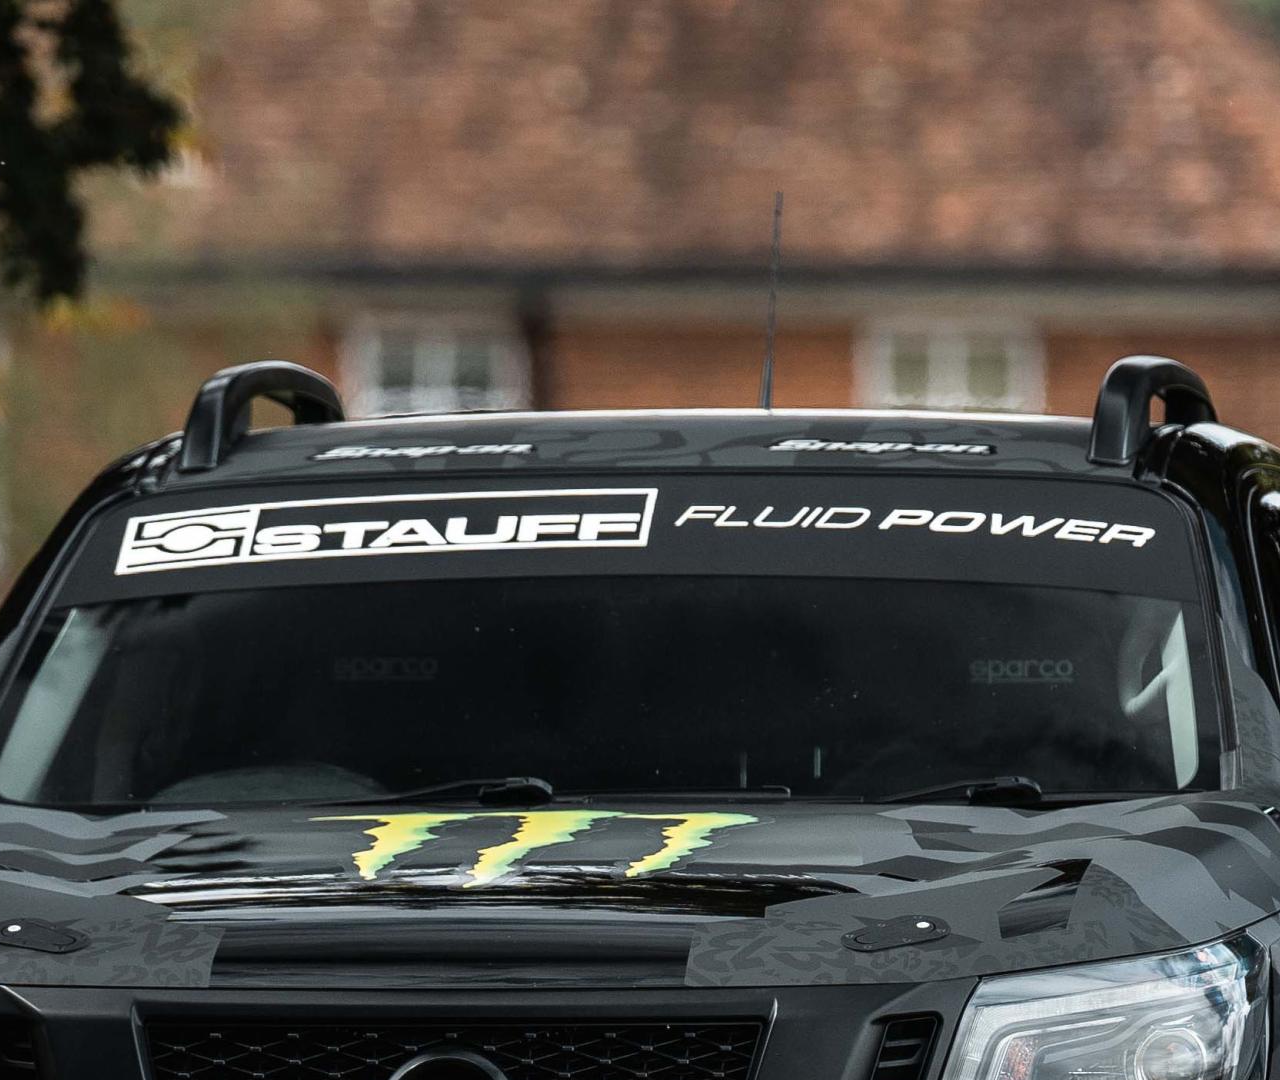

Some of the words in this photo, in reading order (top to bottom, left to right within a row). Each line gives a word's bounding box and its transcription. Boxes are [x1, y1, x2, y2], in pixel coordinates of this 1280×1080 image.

[254, 513, 642, 555] STAUFF
[674, 505, 871, 529] FLUID
[878, 508, 1157, 548] POWER
[334, 656, 439, 681] sparco
[968, 659, 1073, 683] sparco
